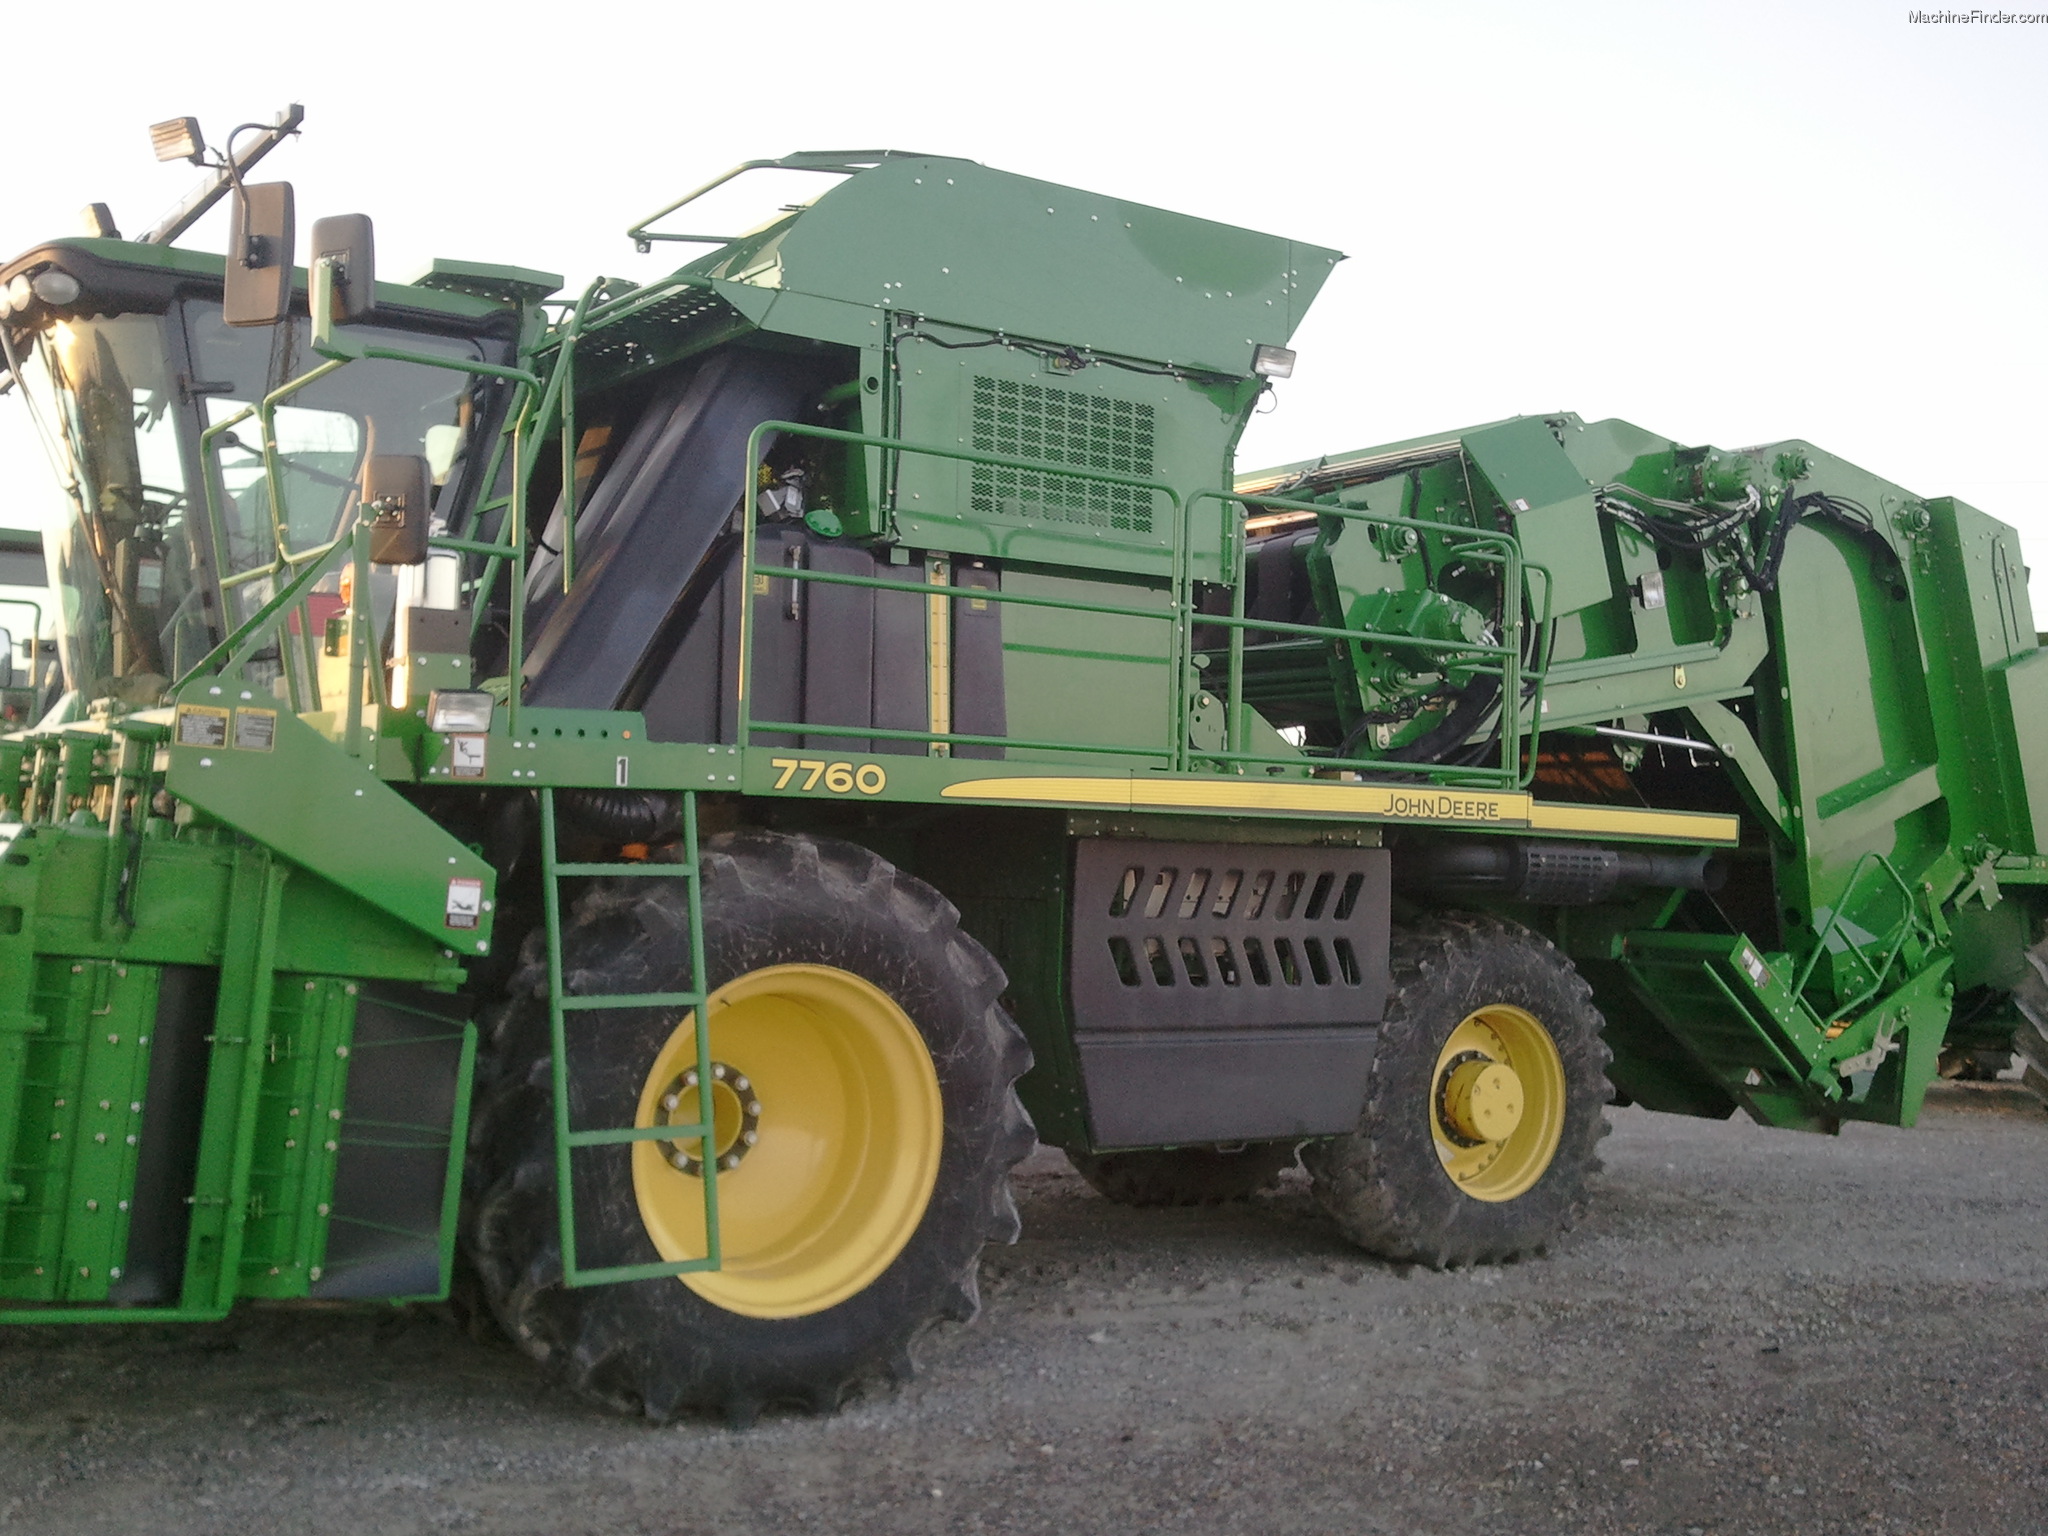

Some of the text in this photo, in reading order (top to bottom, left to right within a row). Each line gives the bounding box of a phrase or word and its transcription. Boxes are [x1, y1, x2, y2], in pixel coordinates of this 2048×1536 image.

[618, 758, 627, 785] 1
[771, 757, 887, 795] 7760
[1383, 793, 1499, 818] JOHN DEERE
